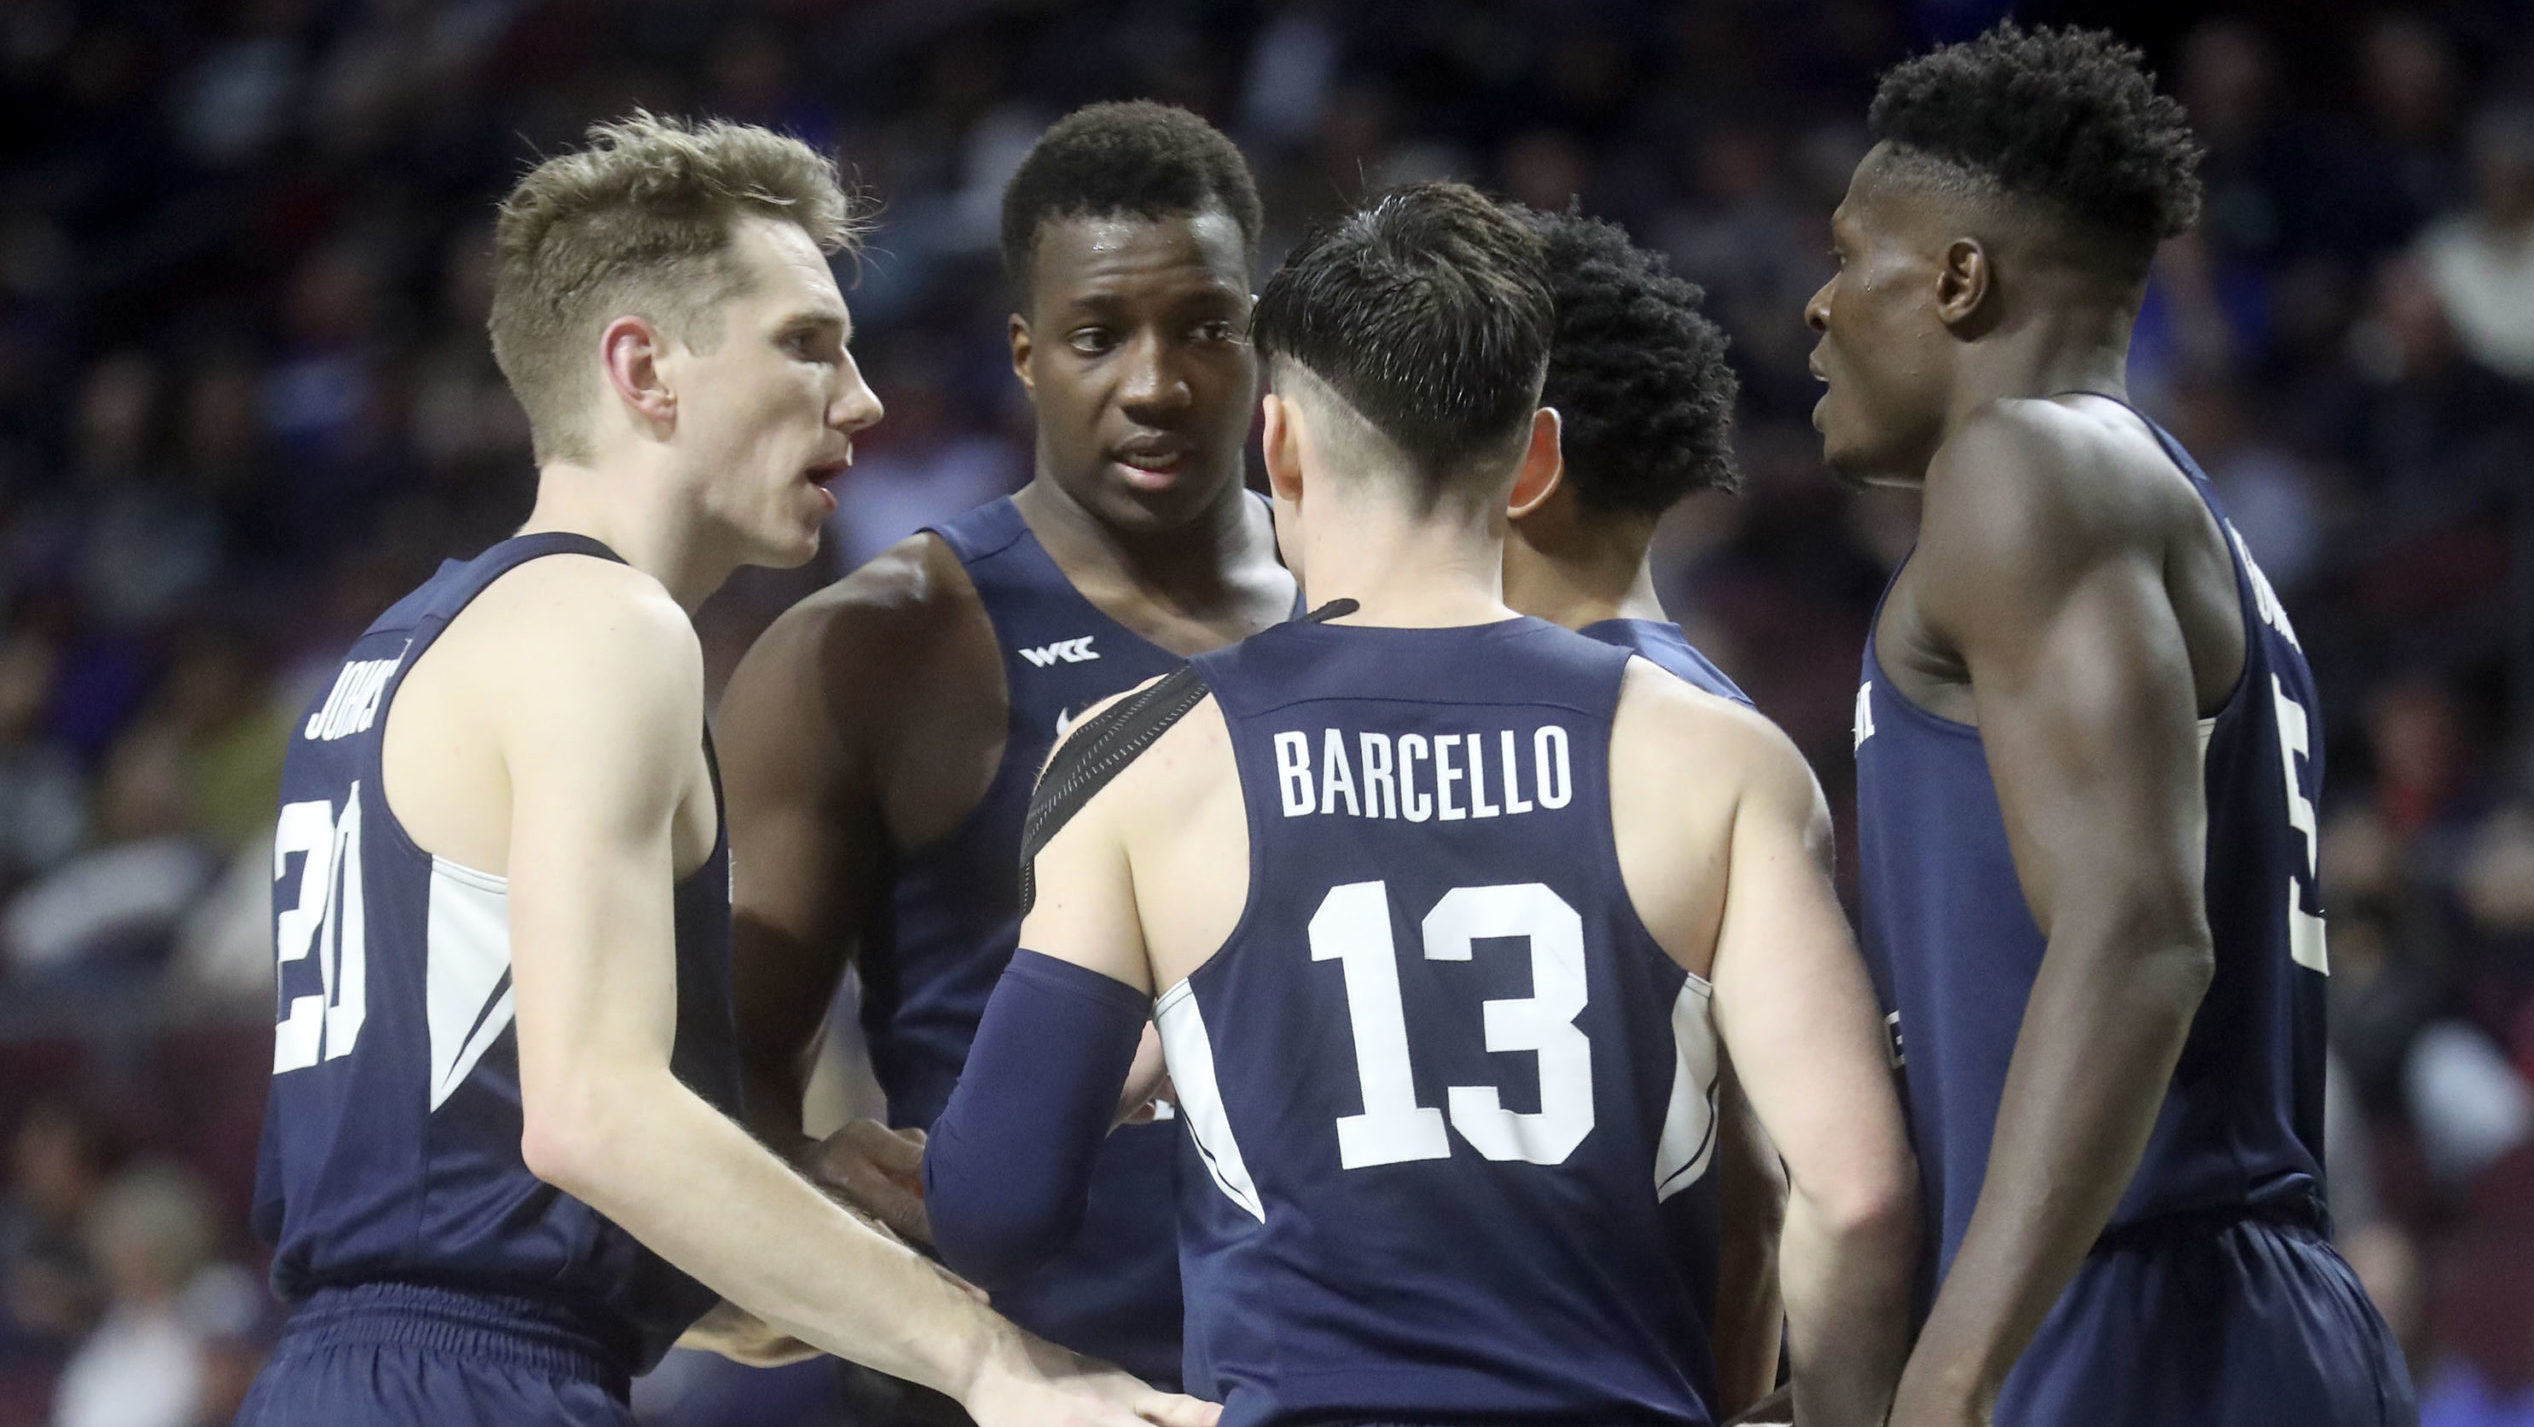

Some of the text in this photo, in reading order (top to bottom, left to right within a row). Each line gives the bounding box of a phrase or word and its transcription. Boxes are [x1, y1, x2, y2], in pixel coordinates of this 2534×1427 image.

[1018, 635, 1100, 668] WCC
[1274, 725, 1572, 822] BARCELLO
[272, 779, 367, 1075] 20
[2270, 673, 2330, 977] 5
[1307, 880, 1595, 1170] 13
